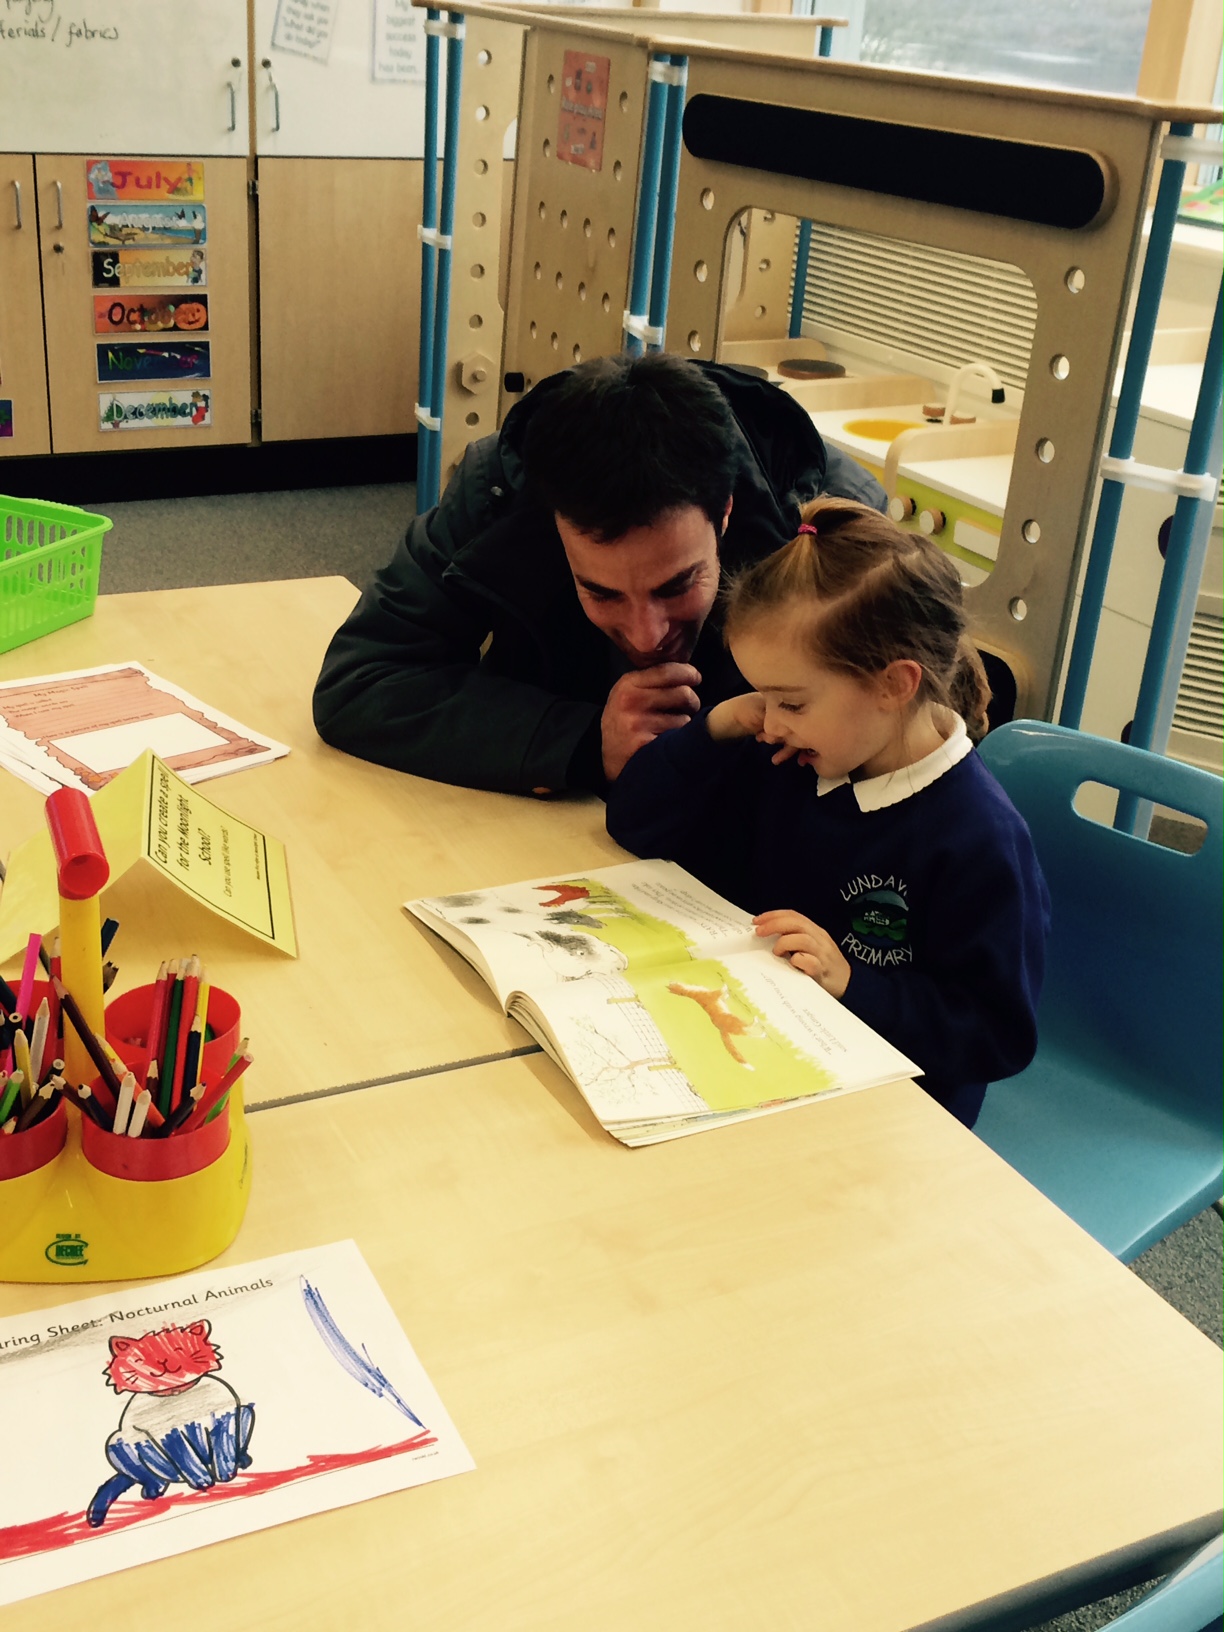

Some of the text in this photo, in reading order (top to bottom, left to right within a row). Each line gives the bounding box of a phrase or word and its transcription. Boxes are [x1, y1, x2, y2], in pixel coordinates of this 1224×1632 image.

[110, 171, 183, 194] July
[102, 256, 194, 283] September
[113, 395, 198, 420] December
[160, 789, 169, 799] a
[158, 796, 168, 827] create
[158, 826, 170, 848] you
[176, 794, 192, 871] for the Moonlight
[155, 844, 168, 864] Can
[198, 828, 212, 866] School?
[840, 874, 908, 901] LUNDAV
[841, 932, 912, 966] PRIMARY
[47, 1318, 104, 1339] Sheet:
[109, 1294, 200, 1323] Nocturnal
[204, 1277, 274, 1301] Animals
